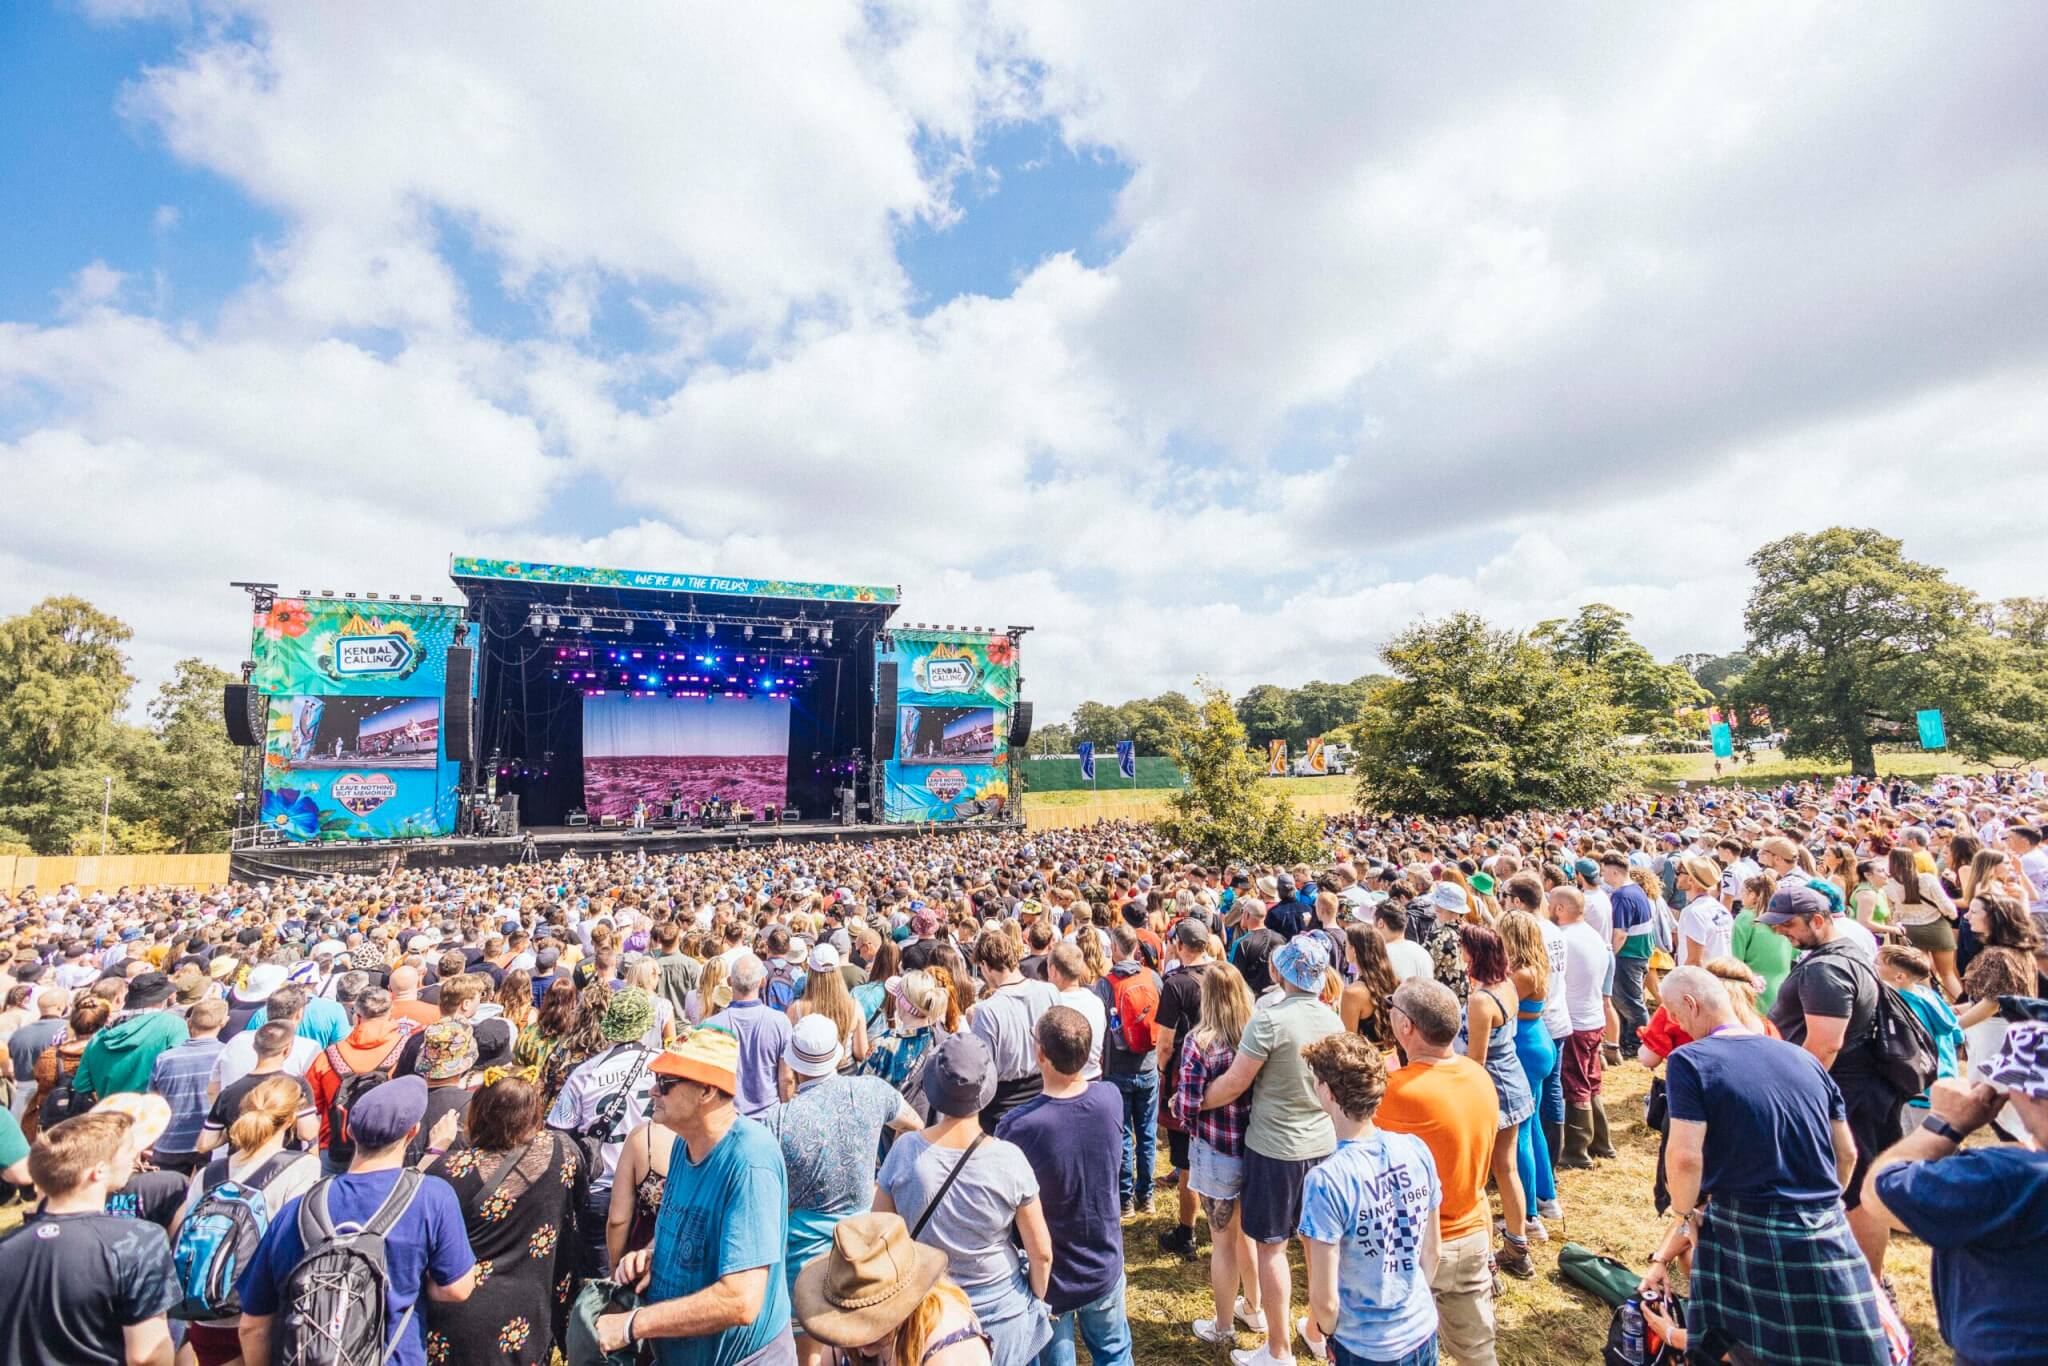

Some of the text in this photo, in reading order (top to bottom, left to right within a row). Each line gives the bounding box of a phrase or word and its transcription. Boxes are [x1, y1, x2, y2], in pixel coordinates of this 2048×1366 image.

[635, 574, 749, 592] WE'RE IN THE FIELDS!
[344, 646, 392, 656] KENDAL
[344, 655, 392, 664] CALLING
[598, 1071, 627, 1087] LUIS
[1364, 1163, 1412, 1202] VANS
[1359, 1185, 1428, 1222] SINCE 1966
[1356, 1225, 1414, 1273] OFF THE
